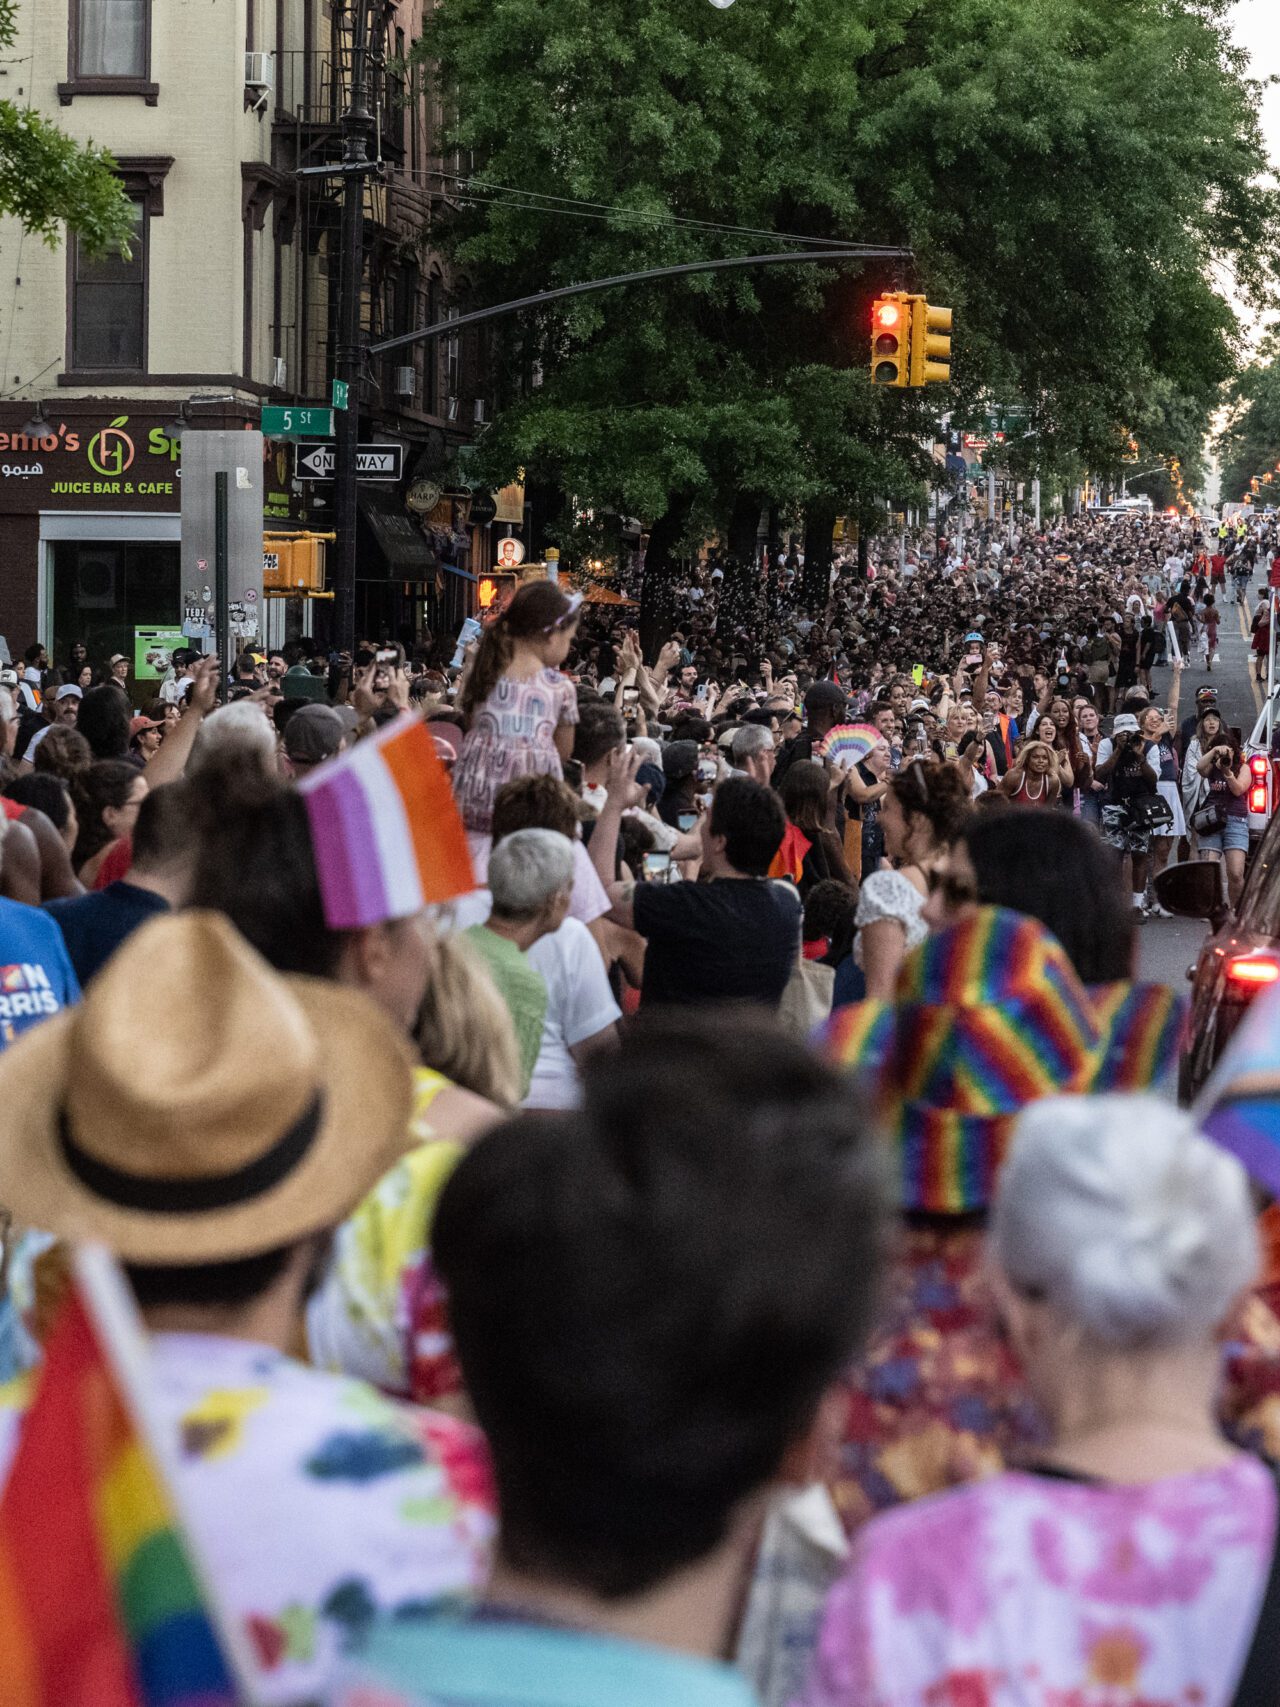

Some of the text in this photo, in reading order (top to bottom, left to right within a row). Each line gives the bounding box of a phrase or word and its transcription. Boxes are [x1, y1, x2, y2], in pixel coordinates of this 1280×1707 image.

[283, 411, 312, 430] 5 St
[356, 455, 387, 469] WAY
[51, 482, 173, 494] JUICE BAR & CAFE
[411, 491, 434, 501] HARP
